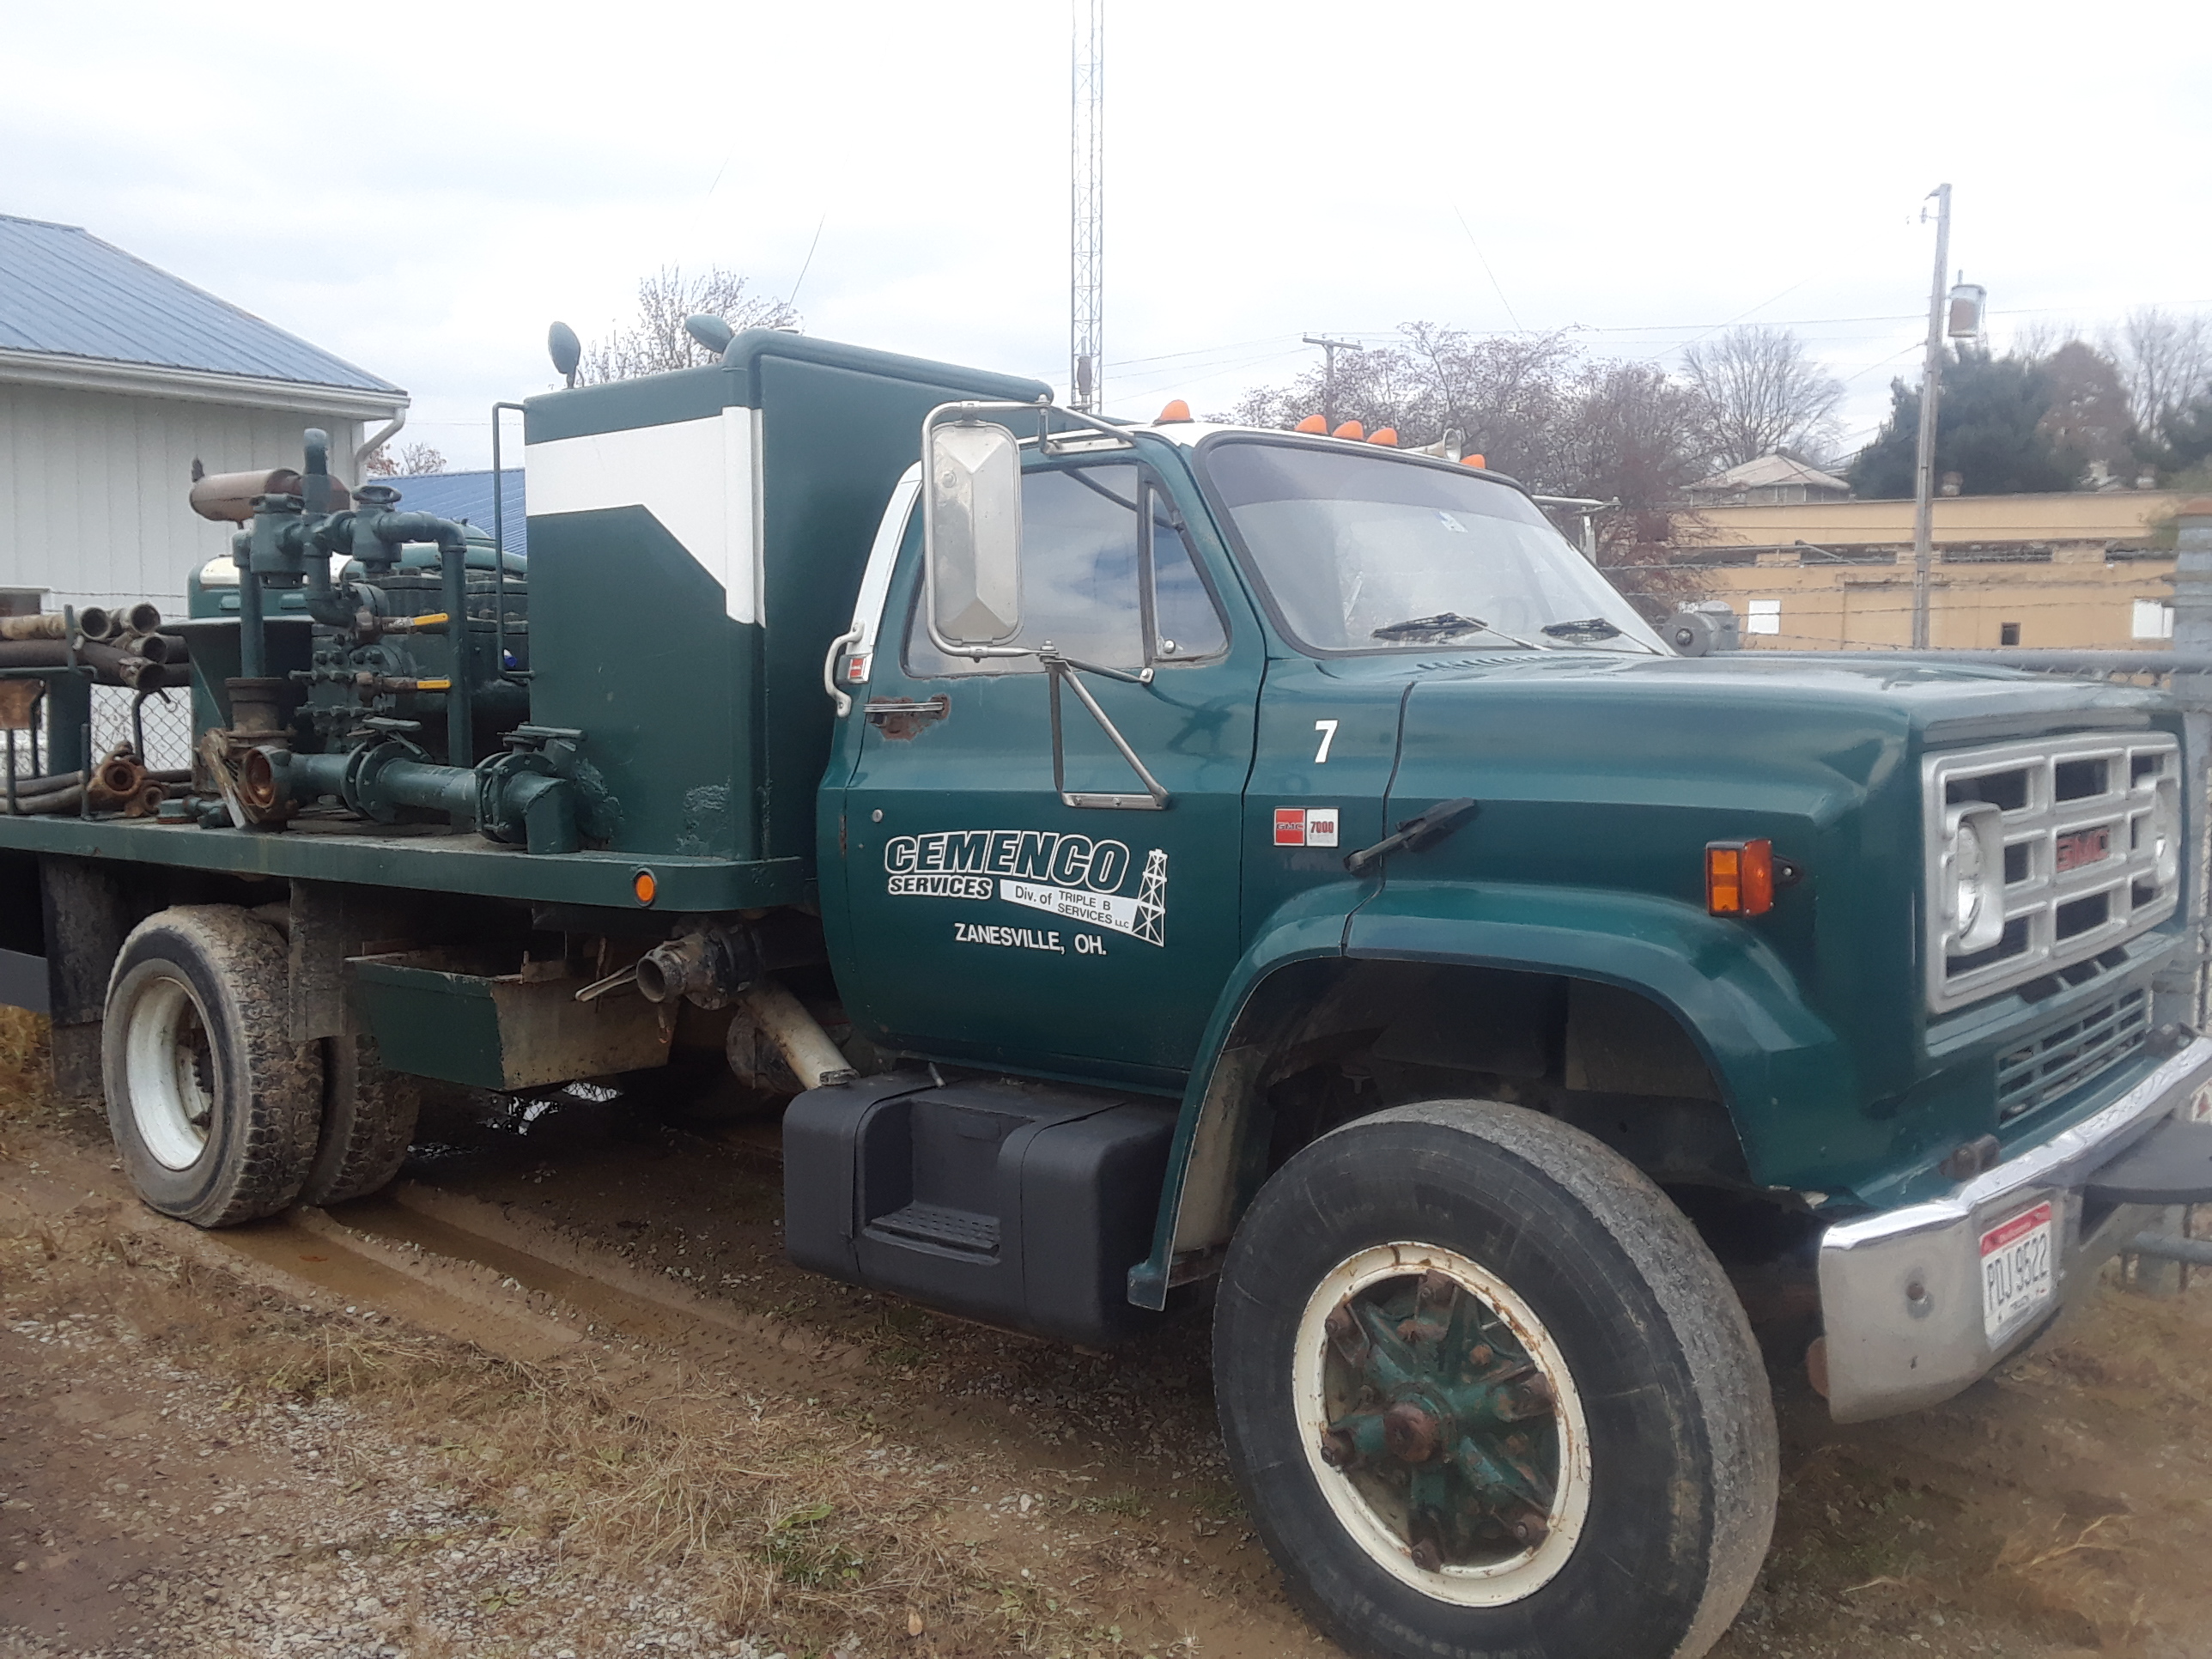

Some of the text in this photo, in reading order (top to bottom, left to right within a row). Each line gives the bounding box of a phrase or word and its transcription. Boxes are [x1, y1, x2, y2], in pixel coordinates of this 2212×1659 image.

[1315, 720, 1338, 763] 7
[1276, 822, 1304, 832] GMC
[1310, 820, 1334, 834] 7000
[884, 830, 1131, 893] CEMENCO
[887, 874, 994, 900] SERVICES
[1015, 885, 1053, 906] Div. of
[1058, 890, 1111, 911] TRIPLE B
[1057, 902, 1130, 929] SERVICES LLC
[954, 921, 1108, 956] ZANESVILLE, OH.
